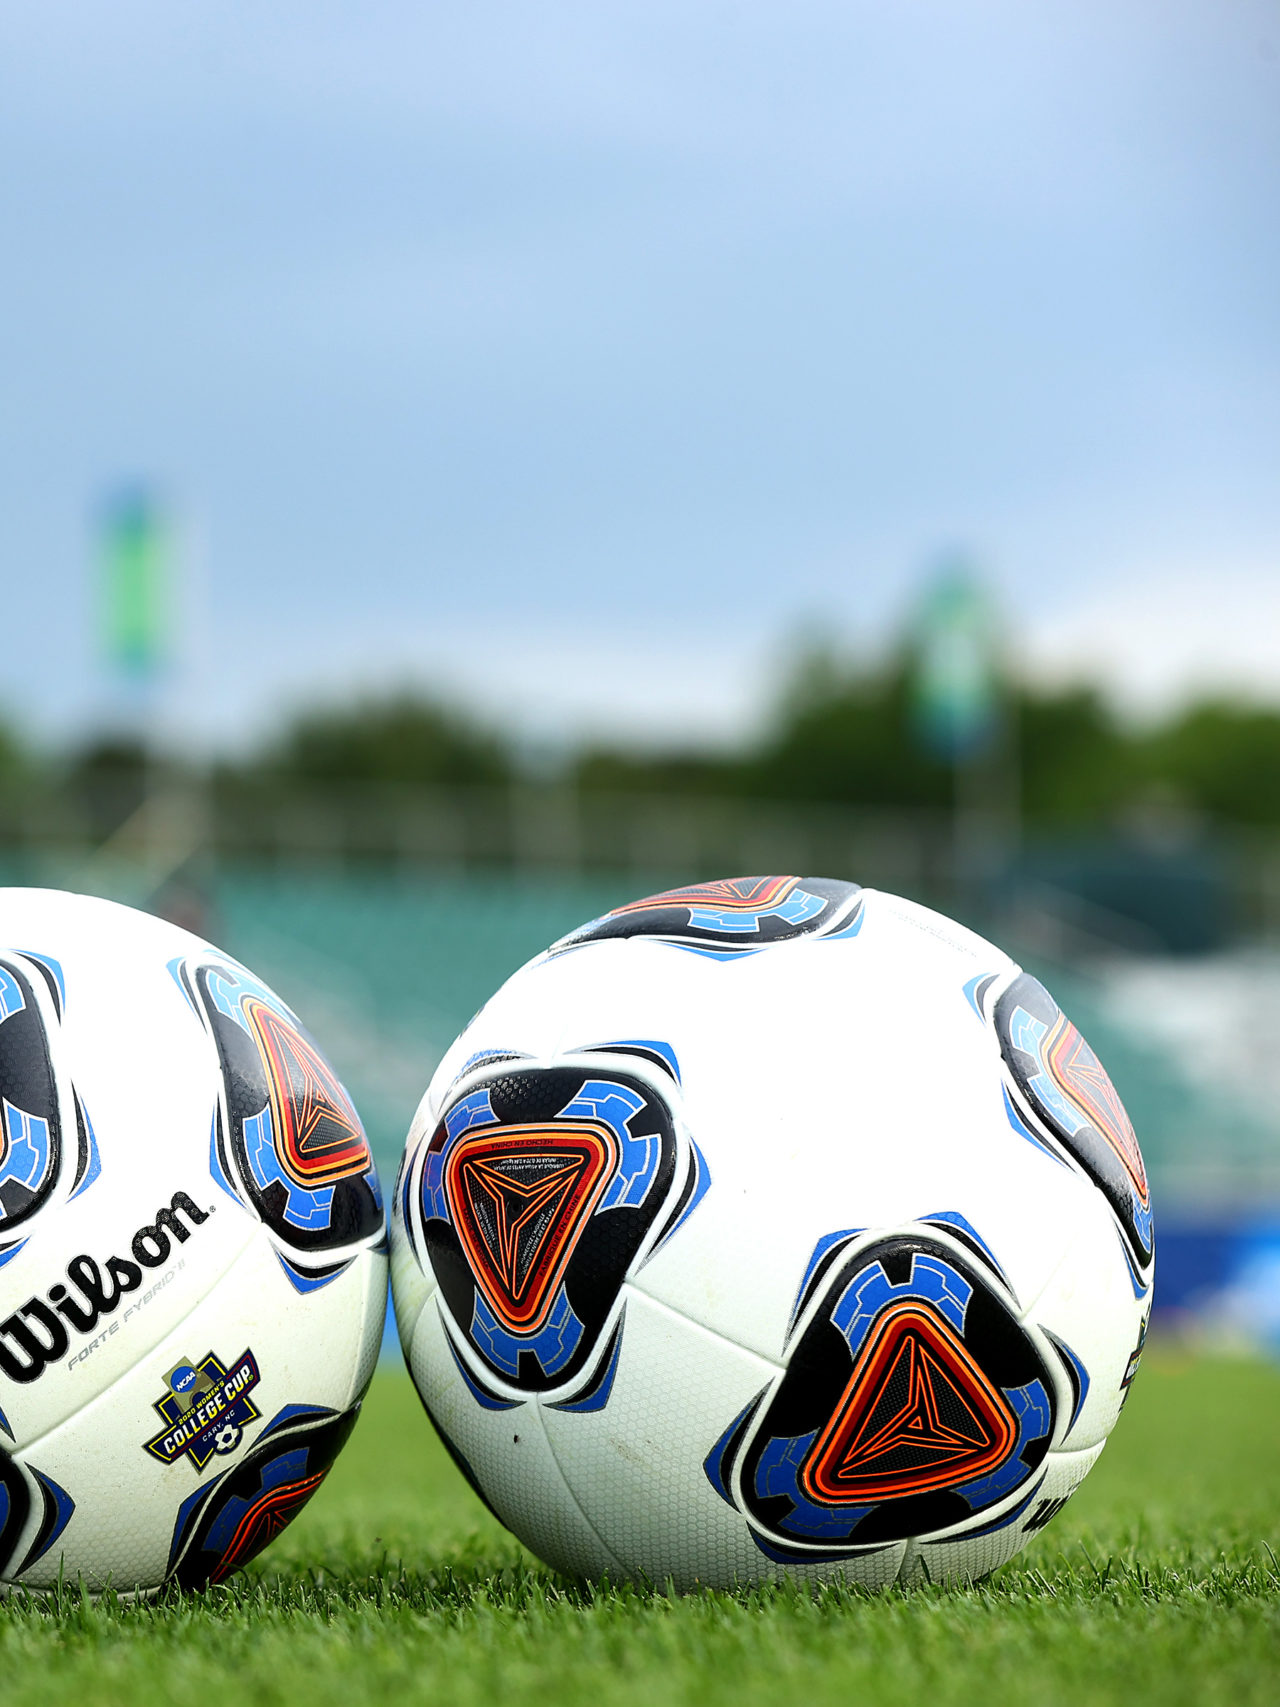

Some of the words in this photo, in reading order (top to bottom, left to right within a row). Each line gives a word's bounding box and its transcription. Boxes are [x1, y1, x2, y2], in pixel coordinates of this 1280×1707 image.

[558, 1221, 567, 1234] EN
[564, 1193, 580, 1221] CHINE
[66, 1321, 121, 1371] FORTE
[122, 1270, 176, 1323] FYBRID
[175, 1371, 196, 1392] NCAA
[177, 1407, 197, 1425] 2020
[195, 1380, 226, 1410] WOMEN'S
[162, 1392, 227, 1455] COLLEGE
[222, 1364, 254, 1402] CUP
[201, 1420, 225, 1442] CARY,
[224, 1409, 236, 1422] NC
